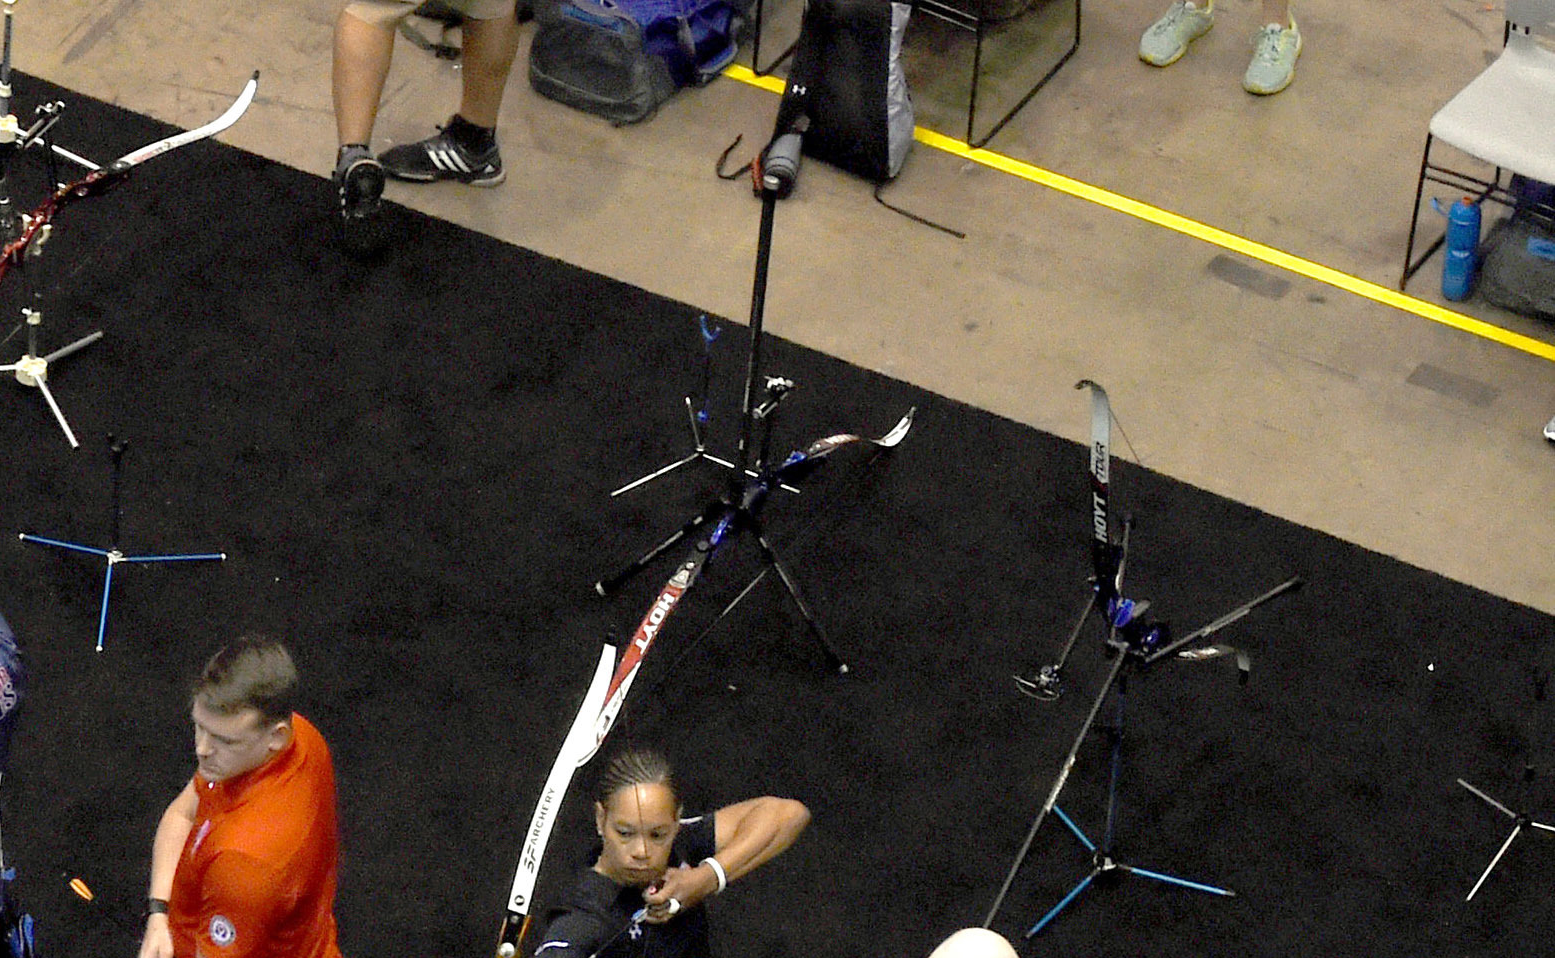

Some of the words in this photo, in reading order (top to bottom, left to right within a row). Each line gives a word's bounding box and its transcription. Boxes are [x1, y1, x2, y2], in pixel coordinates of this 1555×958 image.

[1093, 491, 1108, 544] HOYT
[635, 593, 675, 654] HOYT
[530, 787, 555, 845] ARCHERY
